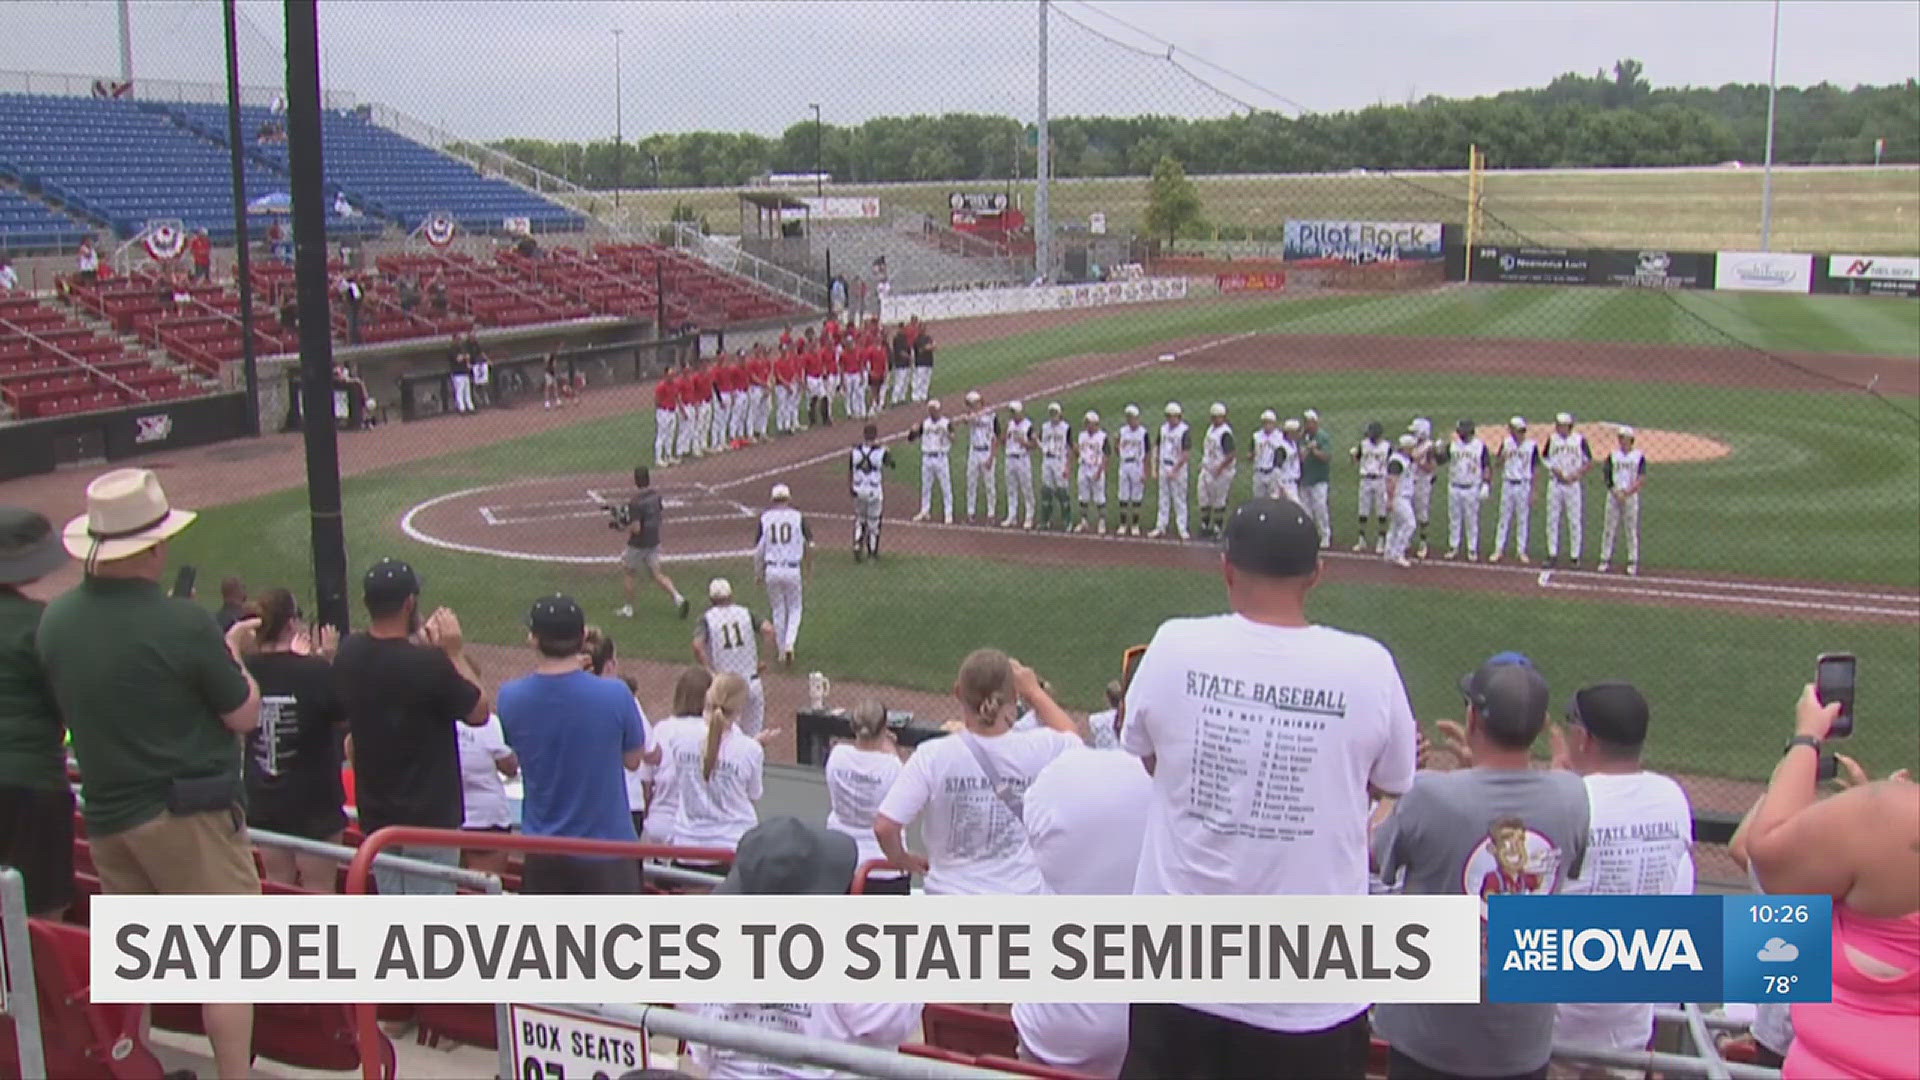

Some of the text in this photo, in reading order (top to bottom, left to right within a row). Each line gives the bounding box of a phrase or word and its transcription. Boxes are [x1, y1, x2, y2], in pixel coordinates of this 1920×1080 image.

[1299, 224, 1424, 246] Pilot Rock
[770, 522, 792, 545] 10
[722, 621, 744, 649] 11
[1186, 670, 1347, 711] STATE BASEBALL
[522, 1020, 636, 1067] BOX SEATS
